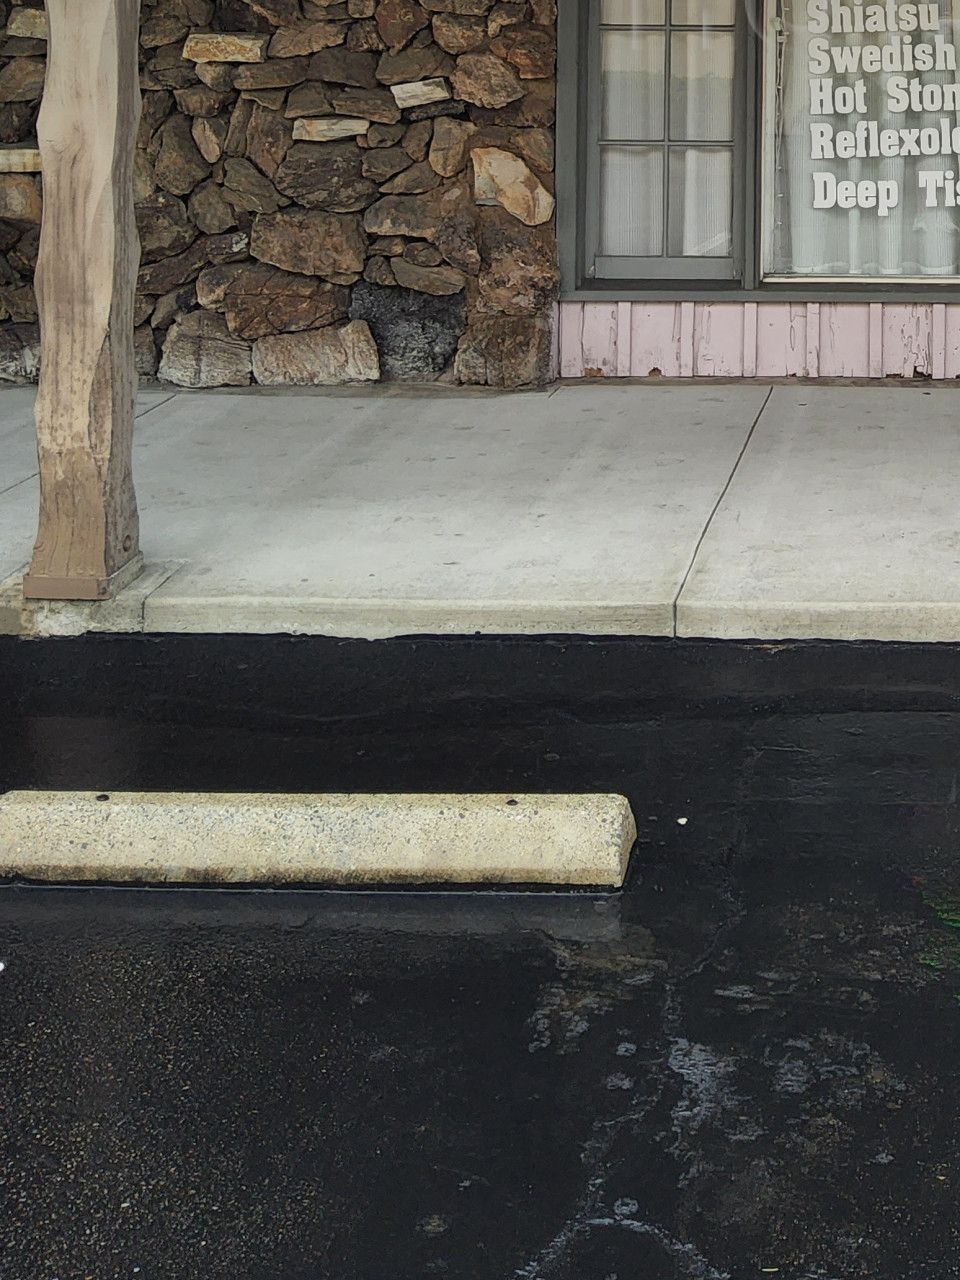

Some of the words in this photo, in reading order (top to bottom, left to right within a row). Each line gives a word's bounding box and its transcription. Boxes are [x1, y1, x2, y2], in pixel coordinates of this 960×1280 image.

[808, 35, 957, 75] Swedish
[809, 77, 867, 115] Hot
[812, 172, 899, 217] Deep
